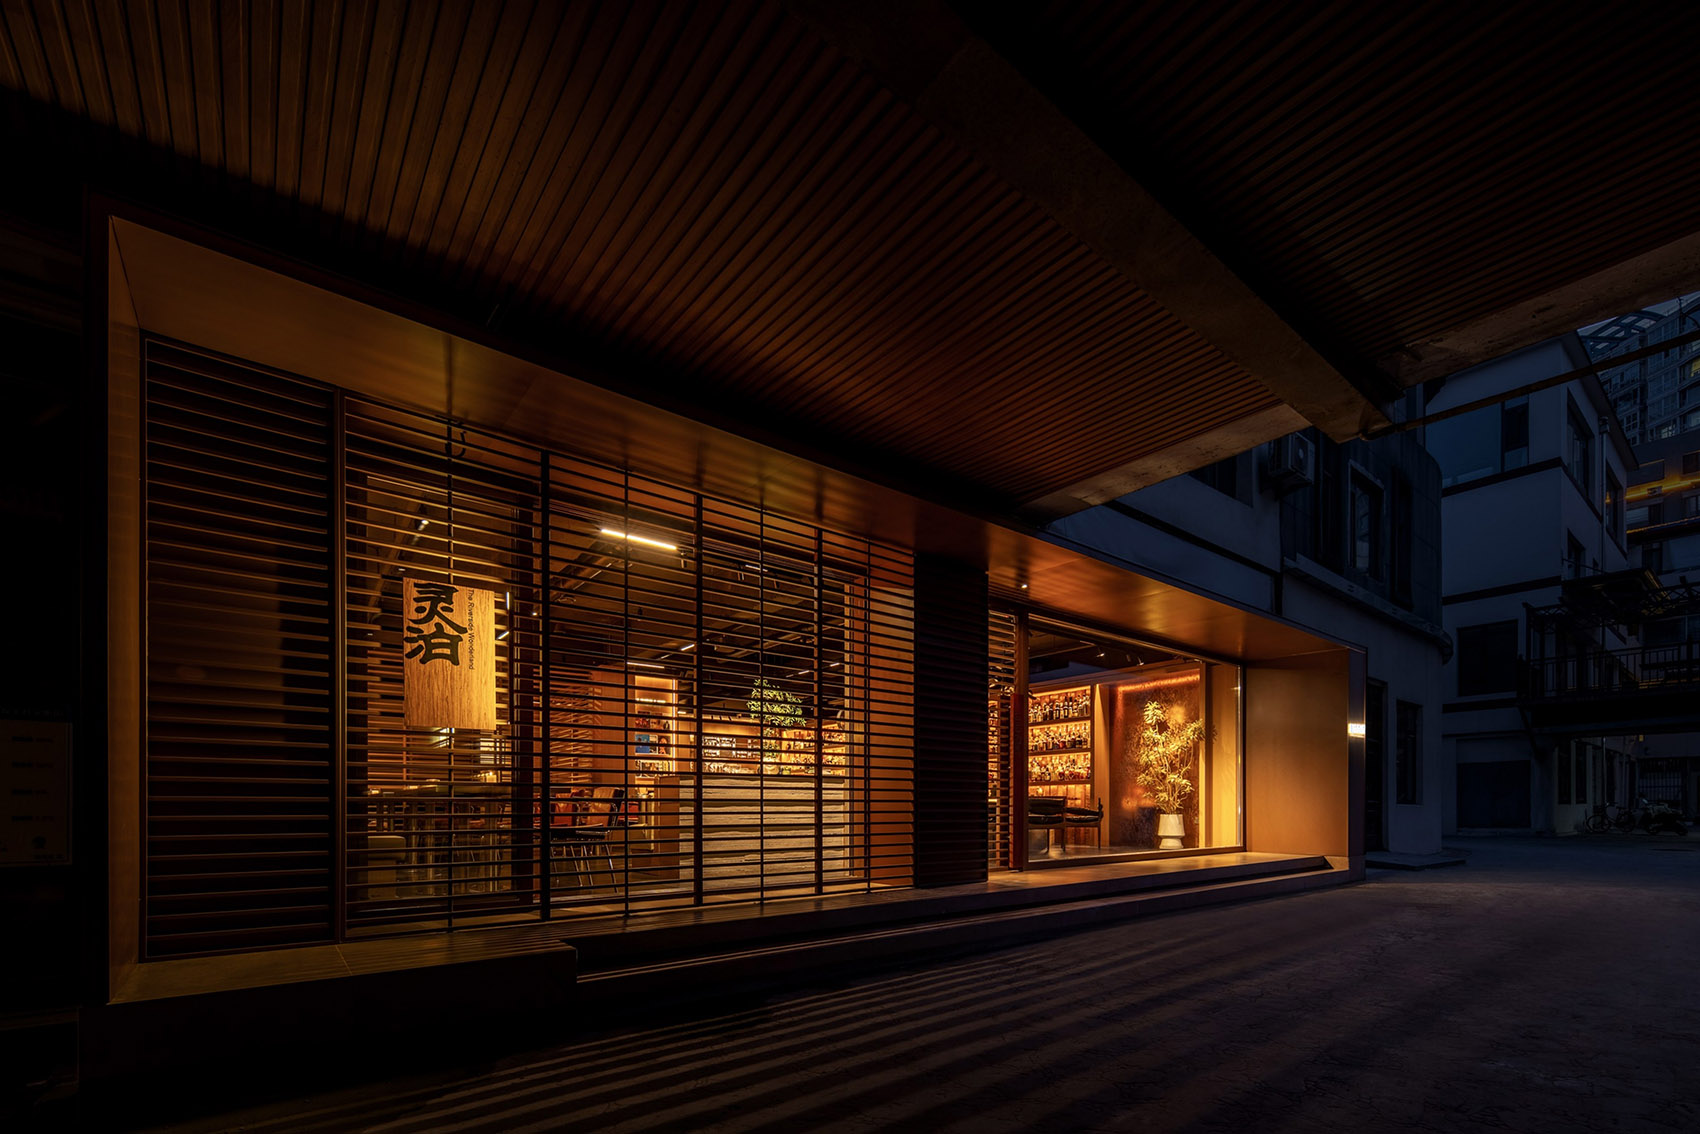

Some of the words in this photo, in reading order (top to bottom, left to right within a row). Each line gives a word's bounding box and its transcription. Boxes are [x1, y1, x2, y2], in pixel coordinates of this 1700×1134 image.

[467, 589, 475, 601] The
[403, 582, 469, 666] 灵泊
[467, 602, 475, 631] Riverside
